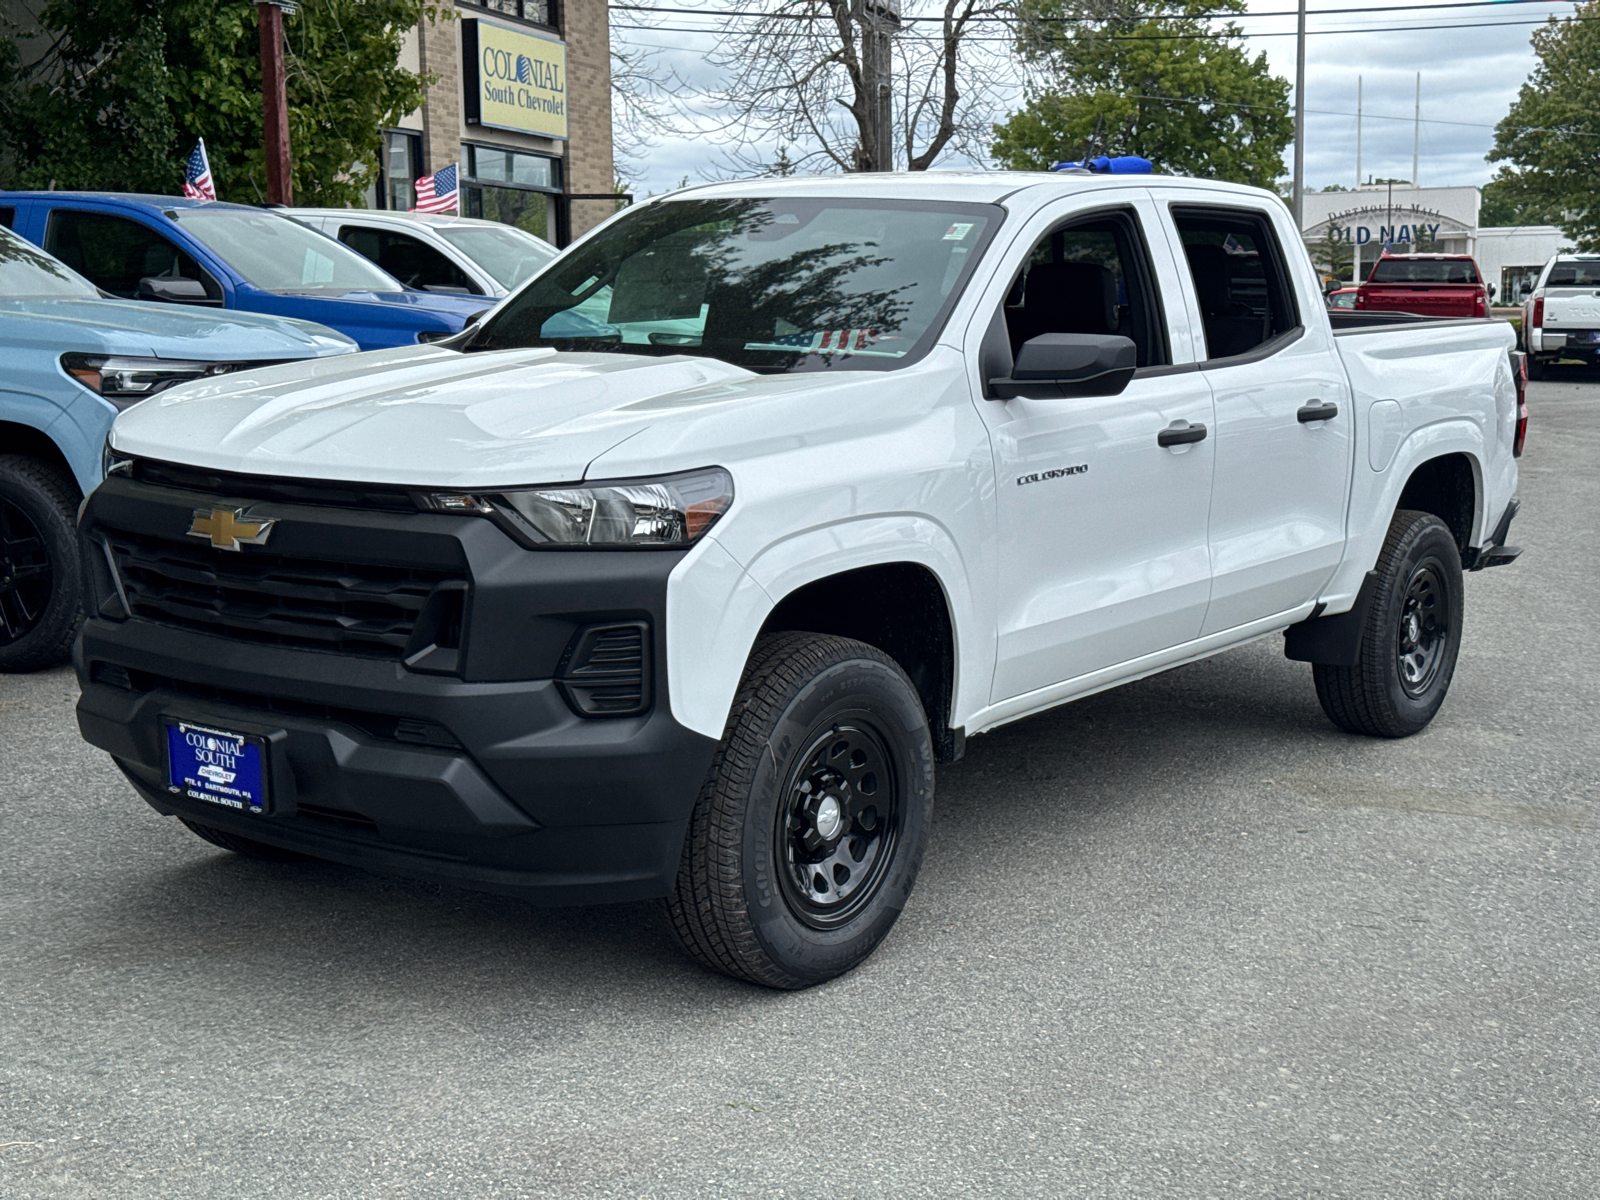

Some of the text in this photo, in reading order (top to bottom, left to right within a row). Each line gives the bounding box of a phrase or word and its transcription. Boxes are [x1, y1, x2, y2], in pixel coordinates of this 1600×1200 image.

[483, 46, 564, 93] COLONIAL
[484, 80, 565, 116] South Chevrolet
[1328, 226, 1371, 245] OLD
[1016, 464, 1088, 486] COLORADO
[186, 732, 245, 757] COLONIAL
[195, 748, 236, 769] SOUTH
[201, 767, 232, 781] CHEVROLET
[187, 790, 243, 809] COLONIAL SOUTH
